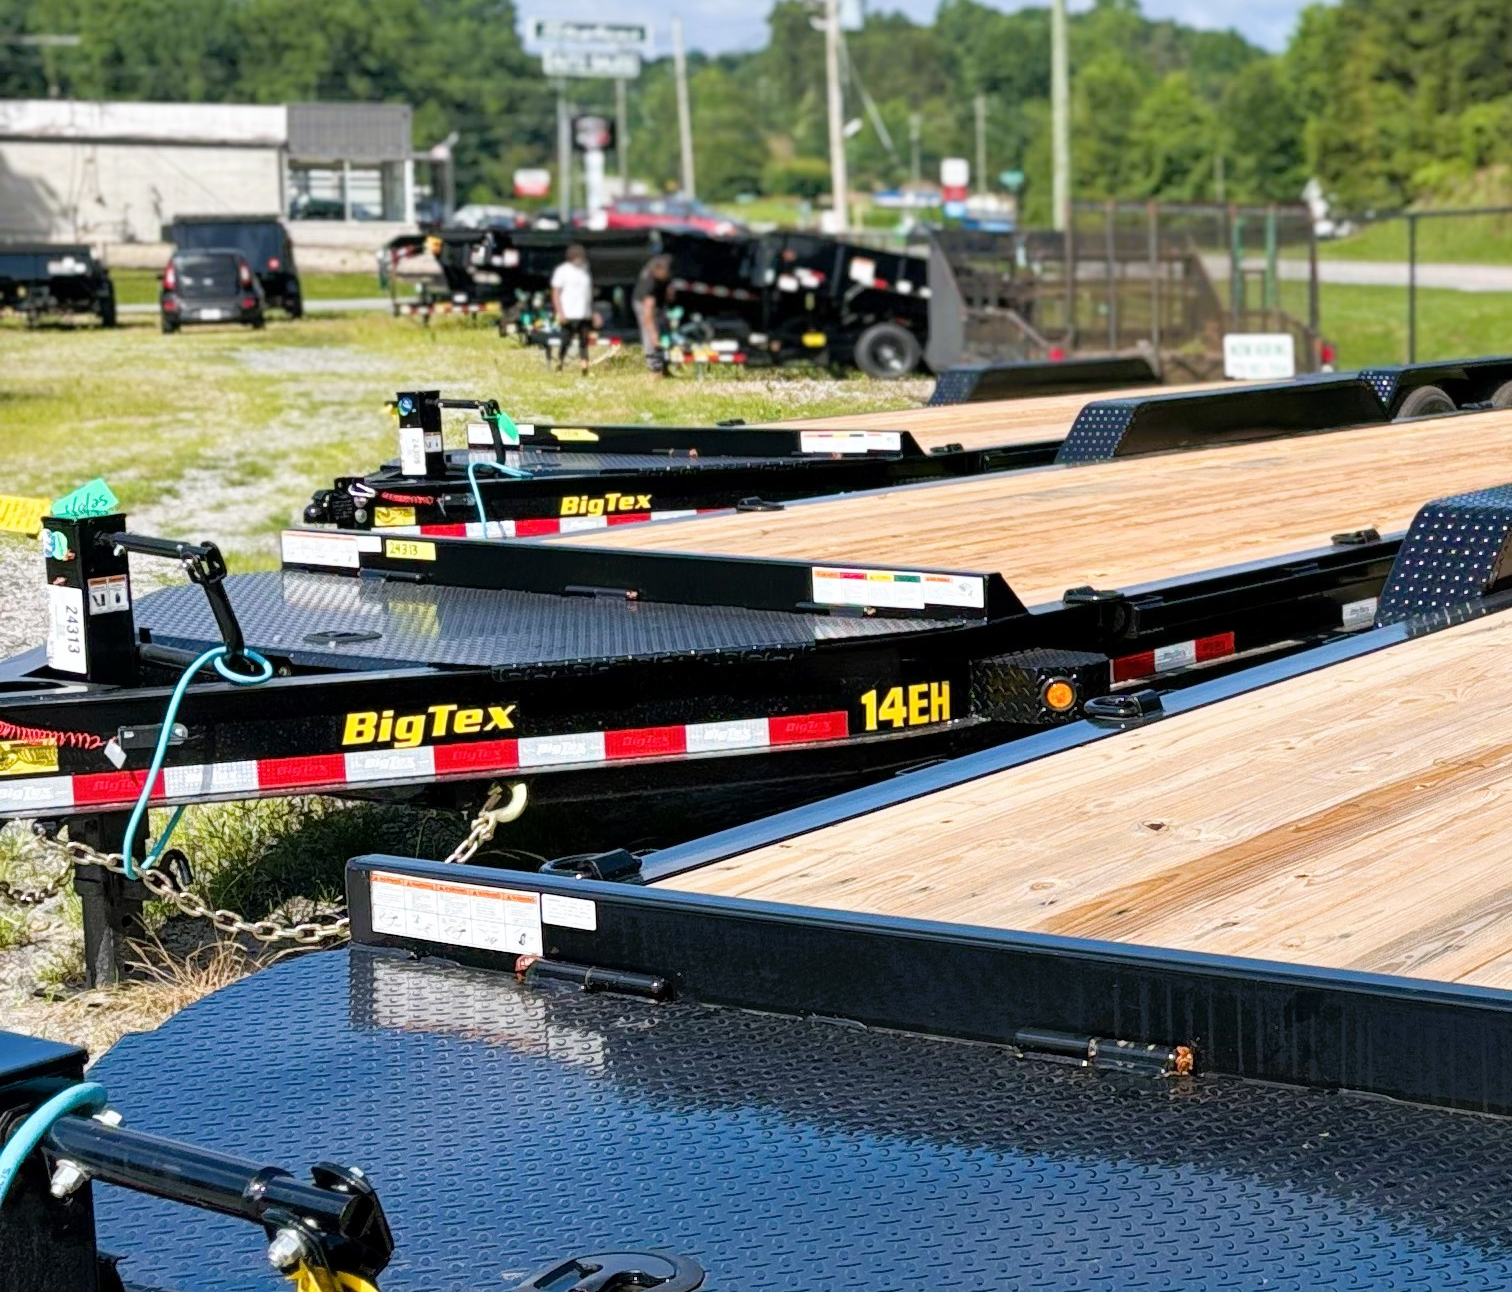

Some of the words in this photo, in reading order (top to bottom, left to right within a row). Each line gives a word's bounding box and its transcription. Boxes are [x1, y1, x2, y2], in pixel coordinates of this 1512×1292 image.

[560, 492, 652, 517] BigTex
[66, 605, 81, 654] 24313
[341, 704, 517, 749] BigTex
[860, 680, 951, 731] 14EH
